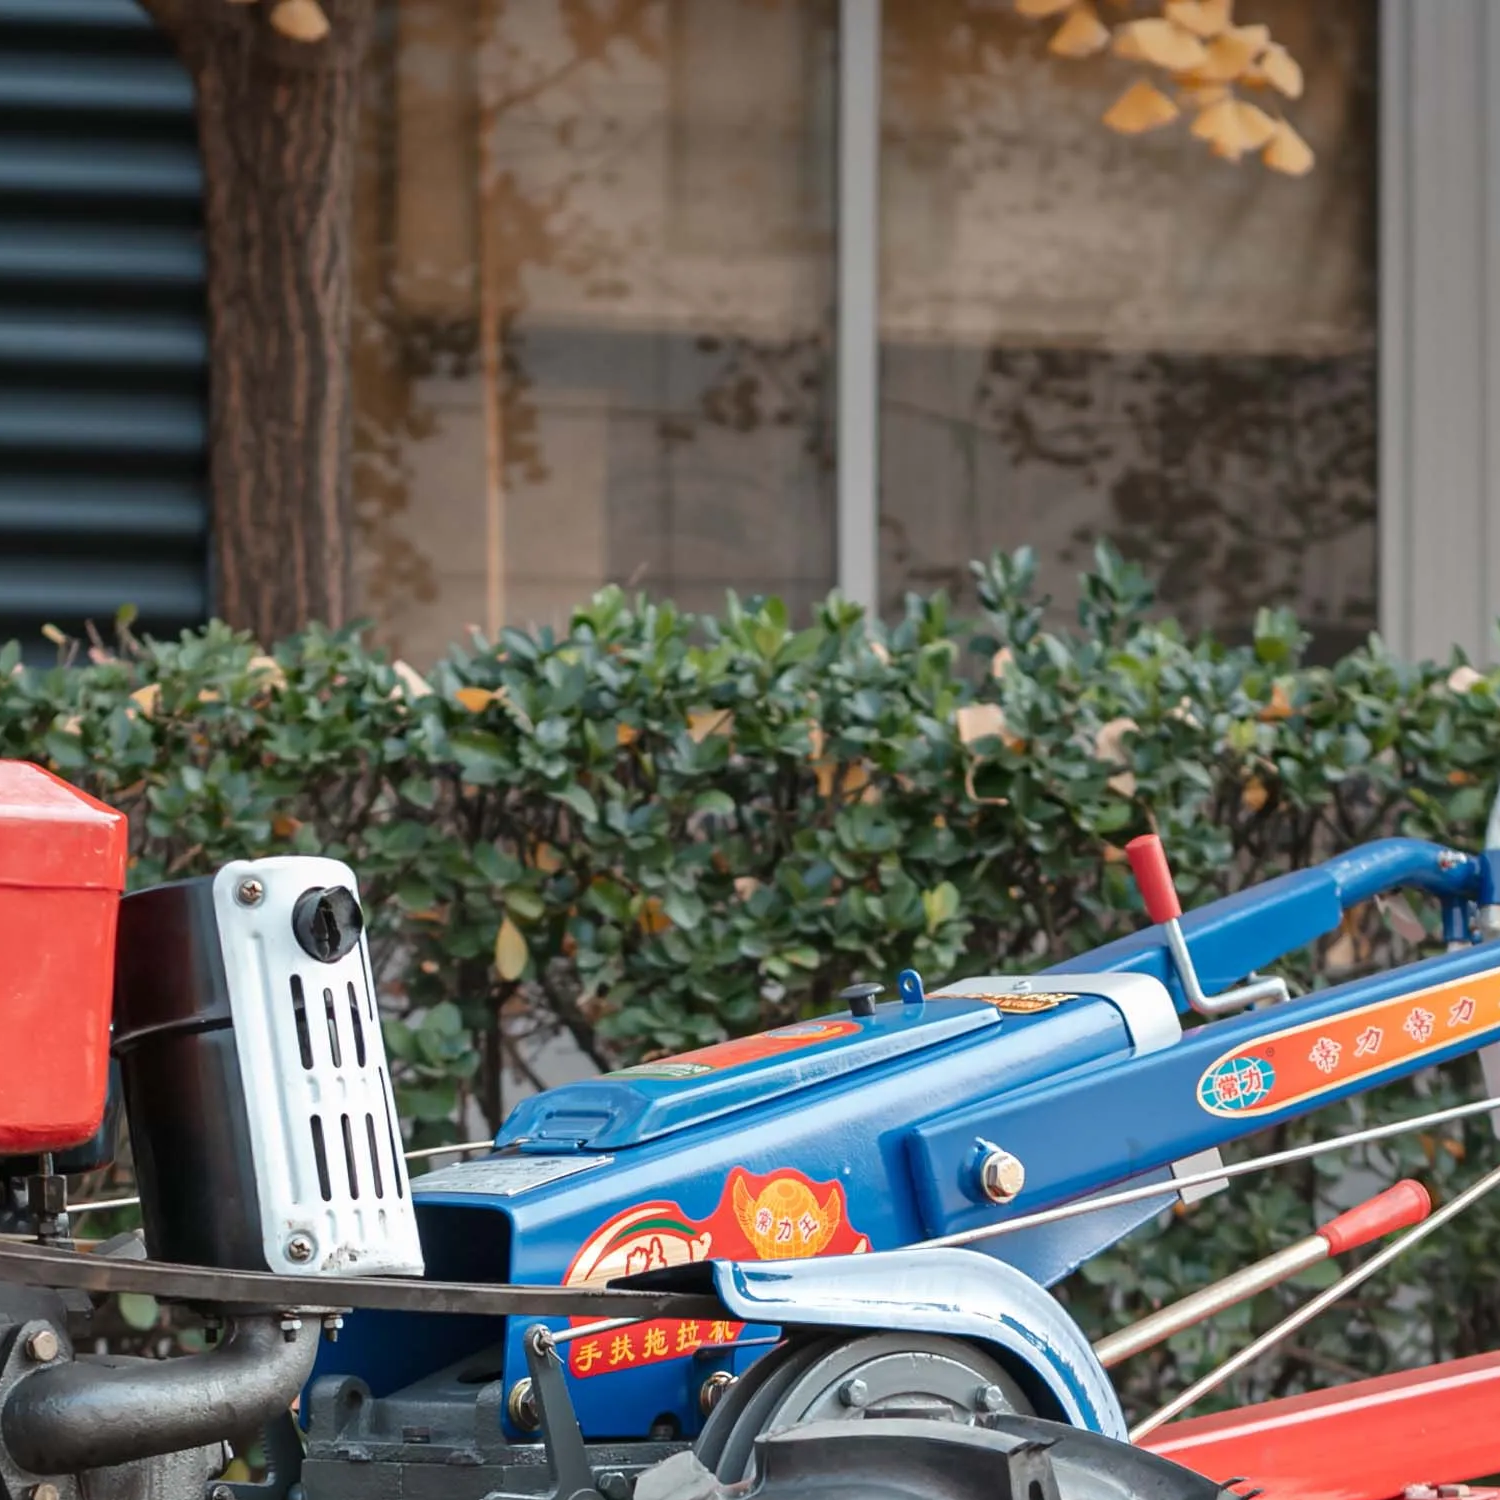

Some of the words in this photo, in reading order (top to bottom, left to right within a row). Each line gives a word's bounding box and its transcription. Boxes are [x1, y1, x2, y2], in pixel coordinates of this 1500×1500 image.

[1217, 1068, 1262, 1101] 常力
[756, 1208, 819, 1243] 常力王
[576, 1321, 735, 1371] 手扶拖拉机
